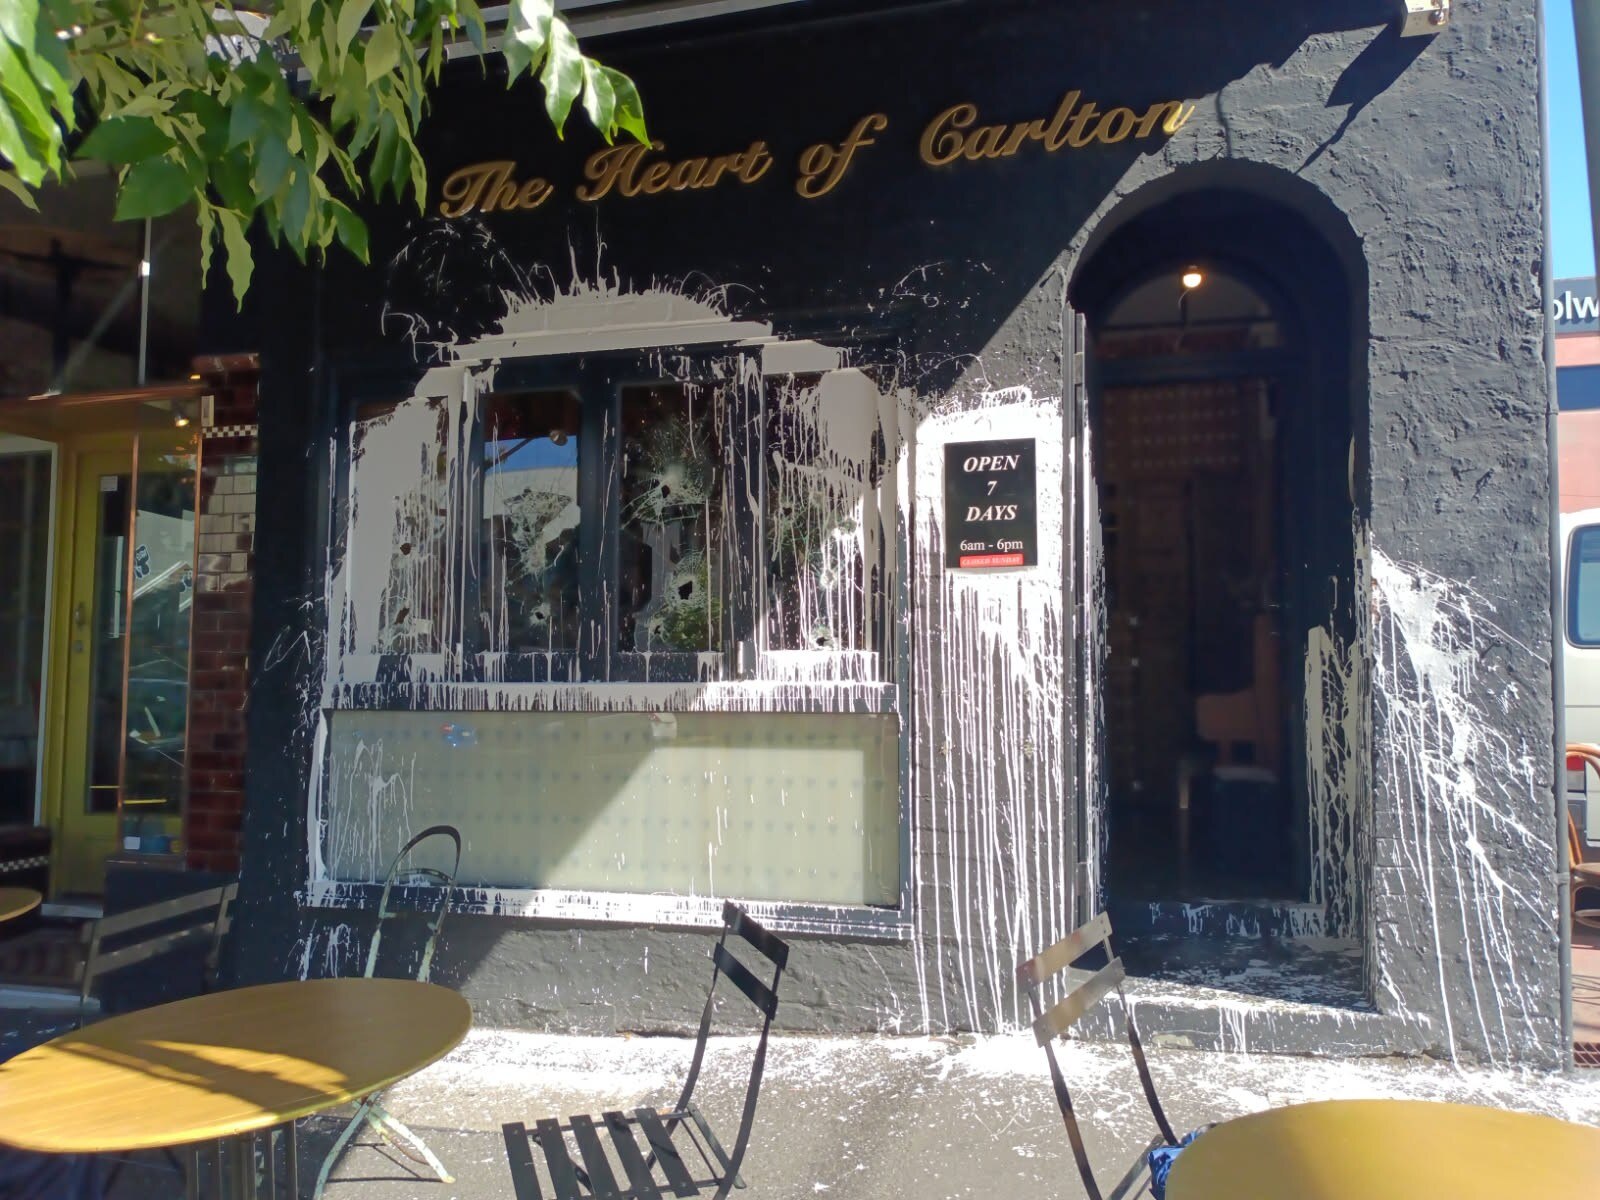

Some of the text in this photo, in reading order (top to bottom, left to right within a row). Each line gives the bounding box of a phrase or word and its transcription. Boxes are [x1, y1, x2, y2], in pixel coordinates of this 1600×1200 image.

[439, 89, 1196, 218] The Heart of Carlton
[963, 454, 1021, 473] OPEN
[986, 480, 998, 496] 7
[965, 504, 1018, 522] DAYS
[959, 540, 986, 551] 6am
[996, 538, 1024, 553] 6pm
